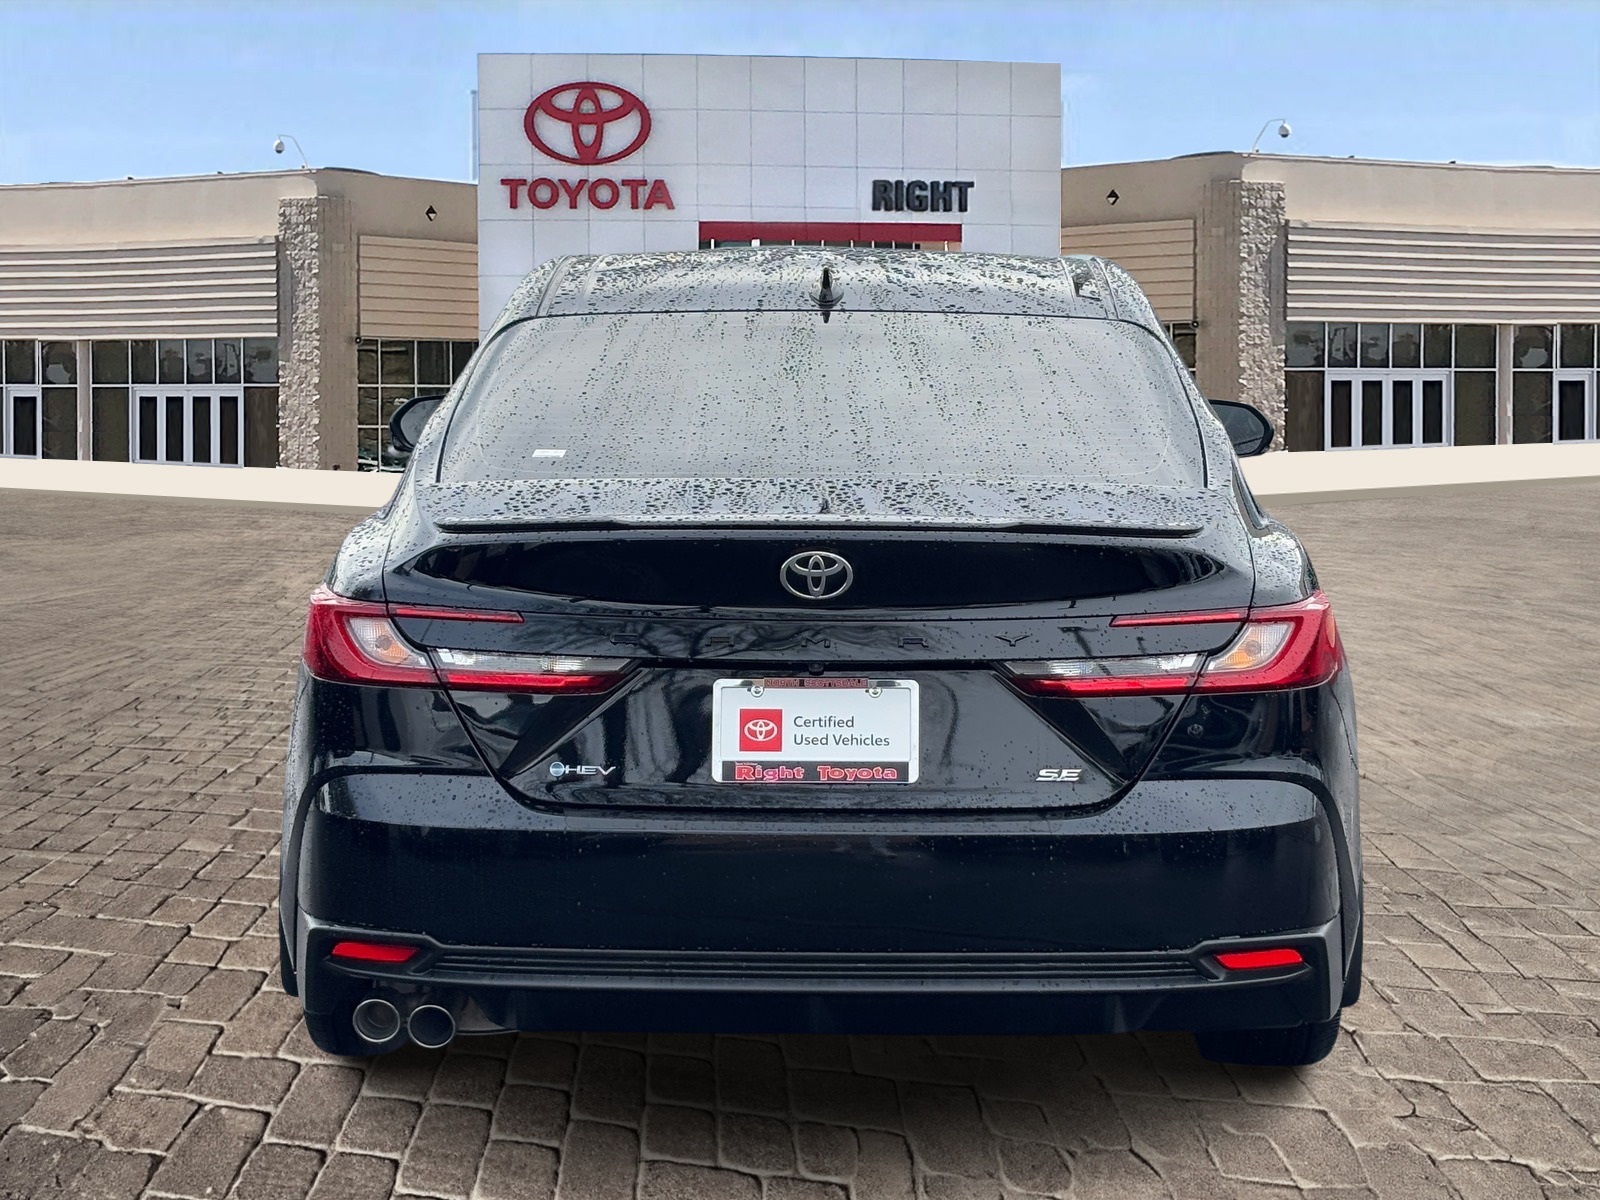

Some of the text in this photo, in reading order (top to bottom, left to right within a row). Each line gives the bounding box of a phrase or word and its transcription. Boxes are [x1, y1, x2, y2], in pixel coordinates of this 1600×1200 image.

[500, 178, 675, 210] TOYOTA
[871, 179, 975, 213] RIGHT
[766, 678, 800, 689] NORTH
[793, 715, 855, 729] Certified
[793, 733, 890, 747] Used Vehicles
[564, 764, 617, 776] HEV
[735, 764, 898, 783] Right Toyota
[1035, 768, 1083, 782] SE
